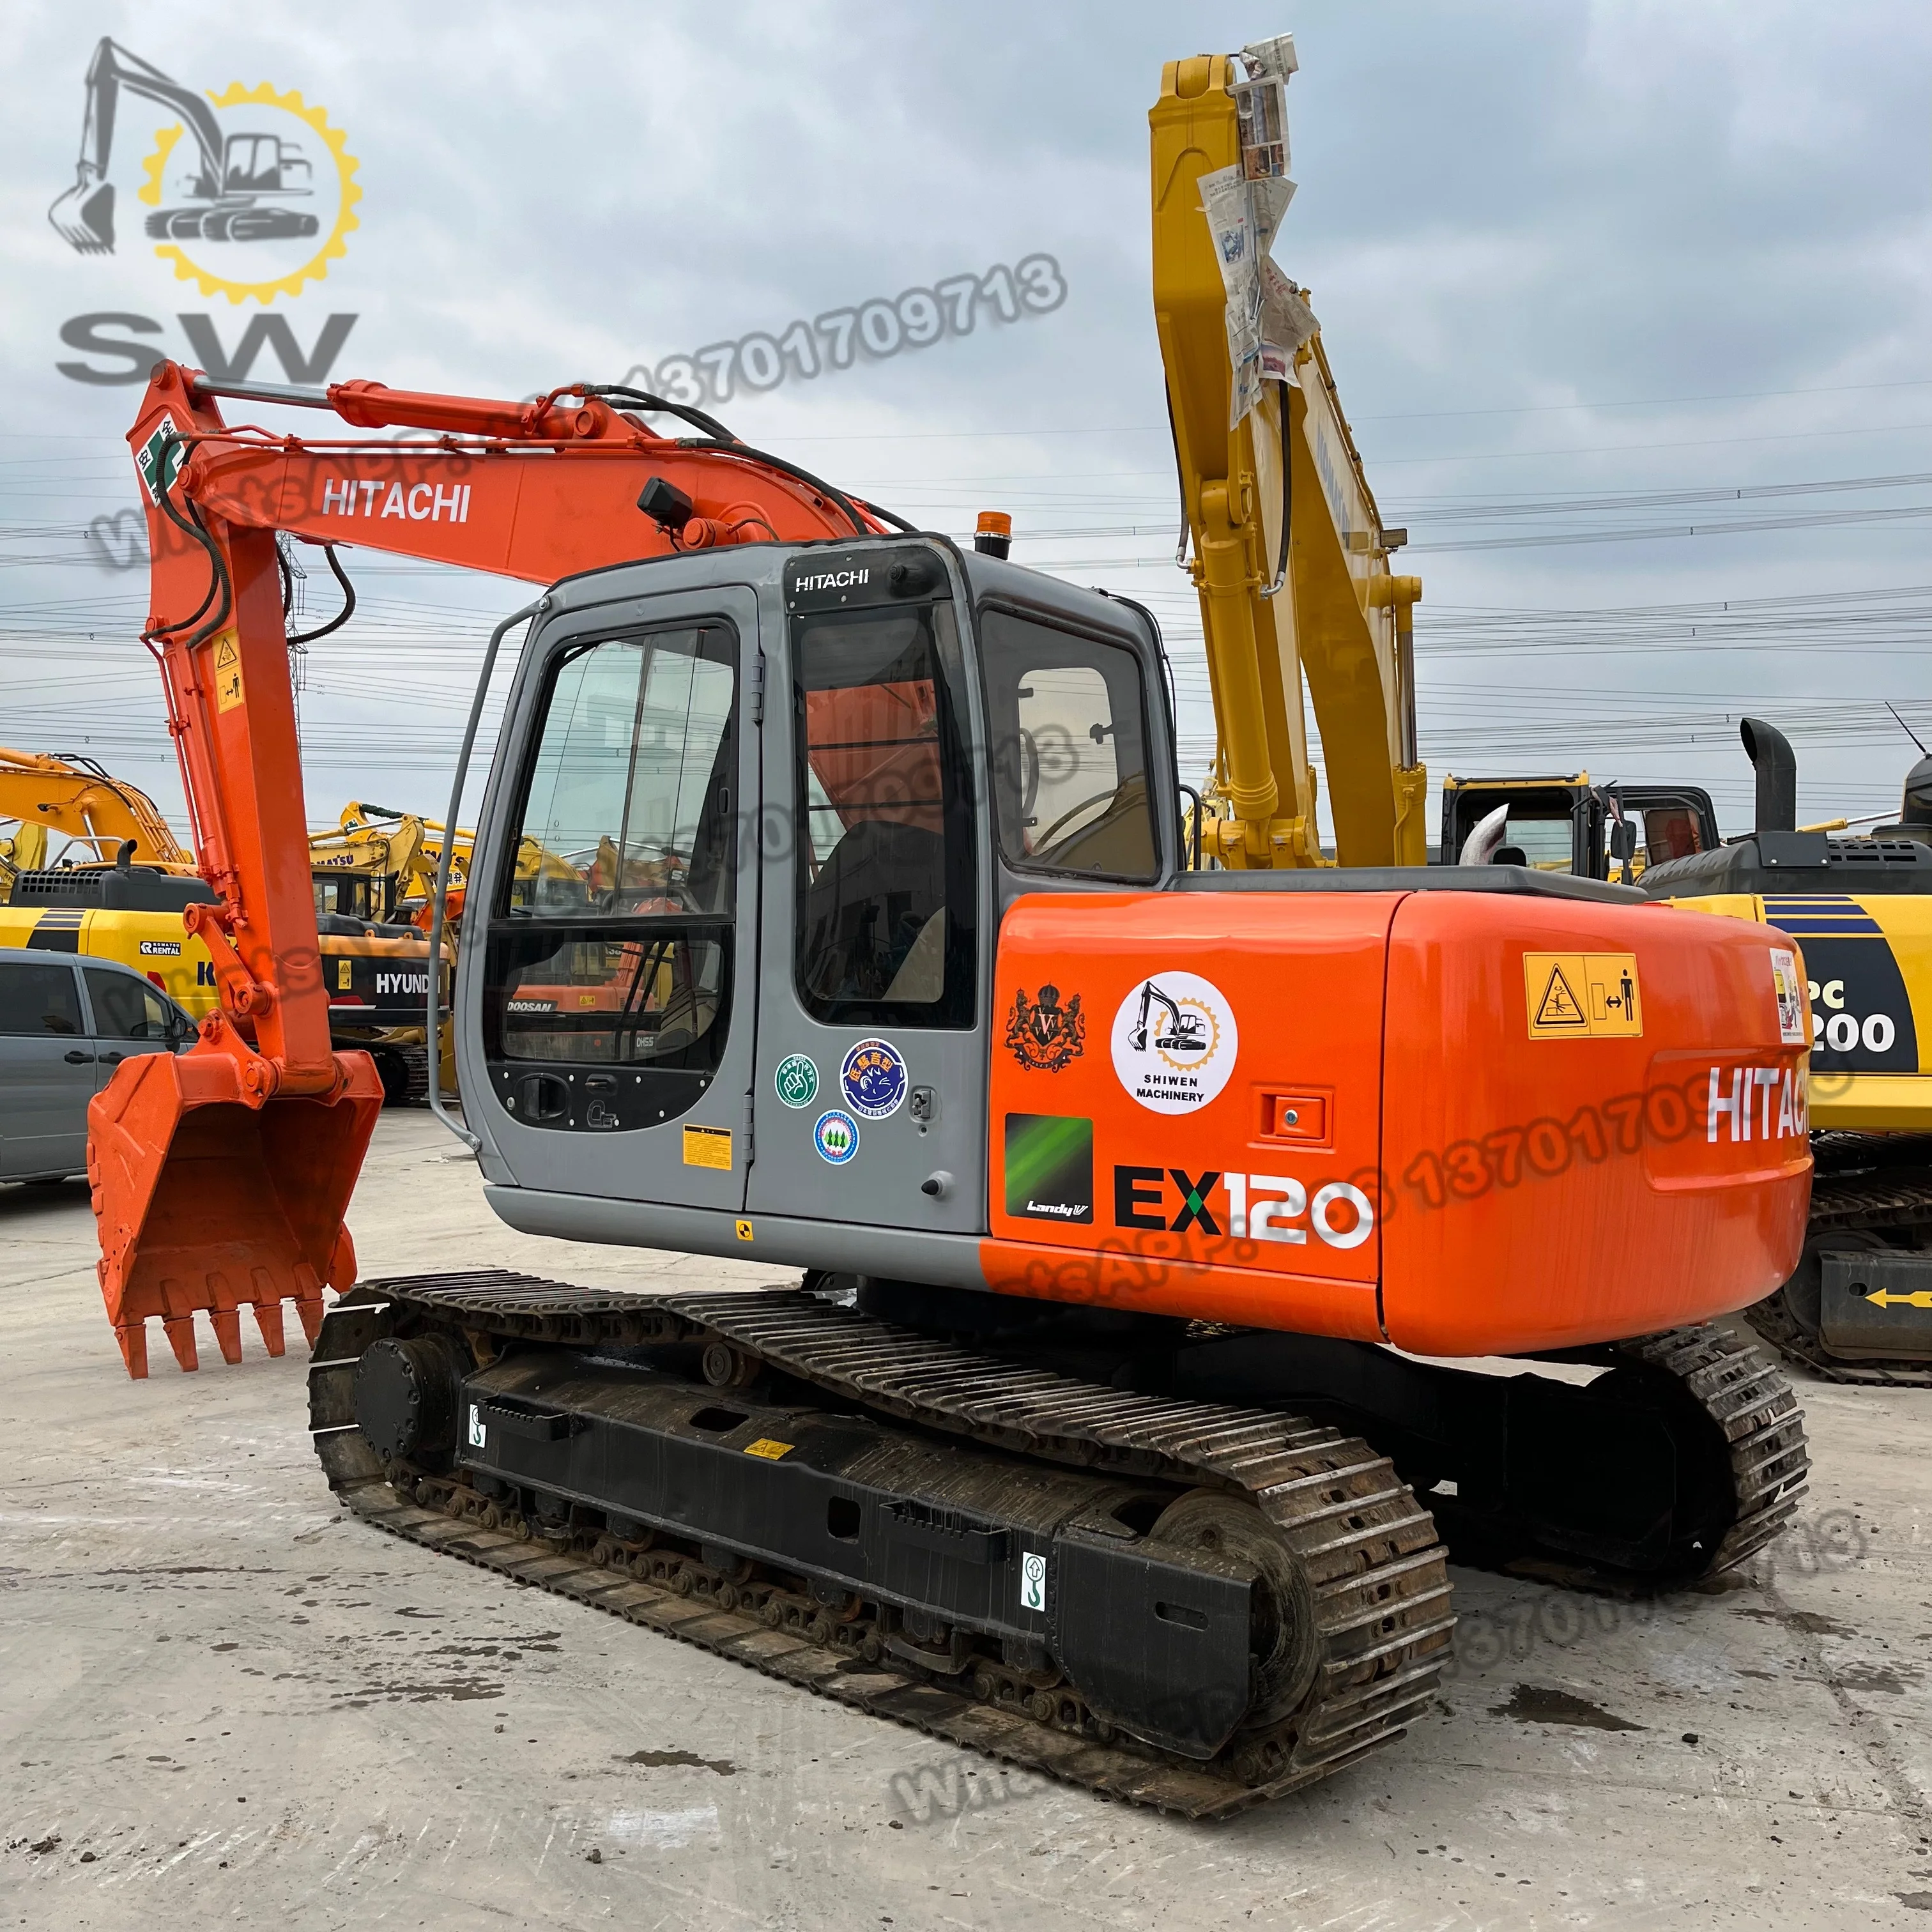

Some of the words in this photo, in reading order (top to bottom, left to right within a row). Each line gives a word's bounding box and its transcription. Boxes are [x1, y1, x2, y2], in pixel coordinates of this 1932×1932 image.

[322, 479, 471, 523] HITACHI
[795, 569, 869, 592] HITACHI
[376, 973, 441, 994] HYUNDI
[1809, 979, 1844, 1009] PC
[507, 1001, 551, 1012] DOOSAN
[1813, 1013, 1896, 1053] 200
[1144, 1074, 1198, 1087] SHIWEN
[1136, 1088, 1205, 1103] MACHINERY
[1114, 1165, 1374, 1249] EX120
